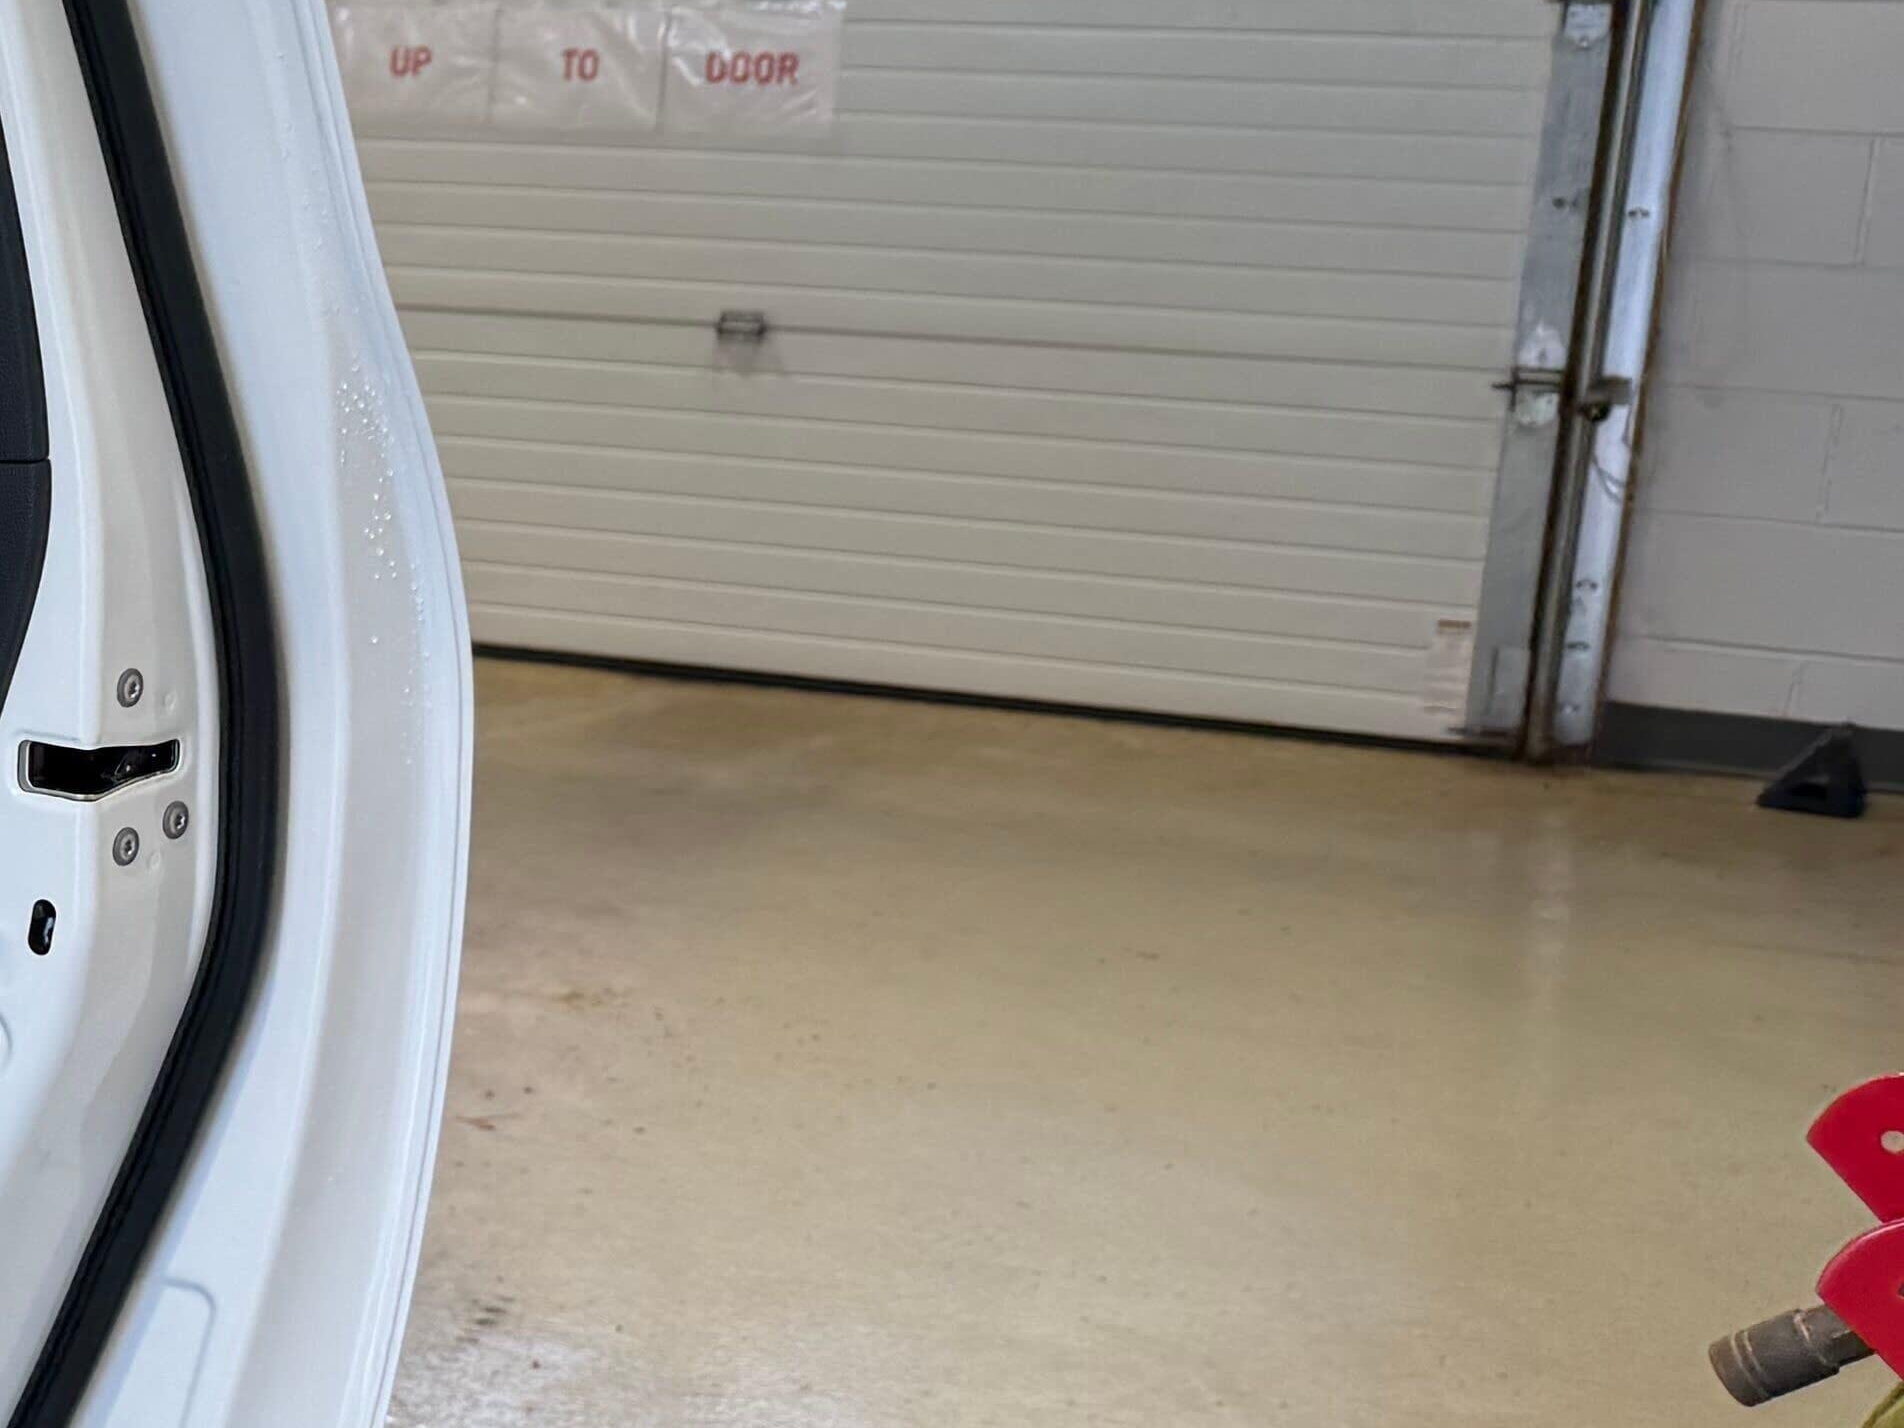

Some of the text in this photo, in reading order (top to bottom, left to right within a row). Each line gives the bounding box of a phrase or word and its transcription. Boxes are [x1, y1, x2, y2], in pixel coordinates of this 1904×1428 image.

[389, 45, 801, 86] UP TO DOOR
